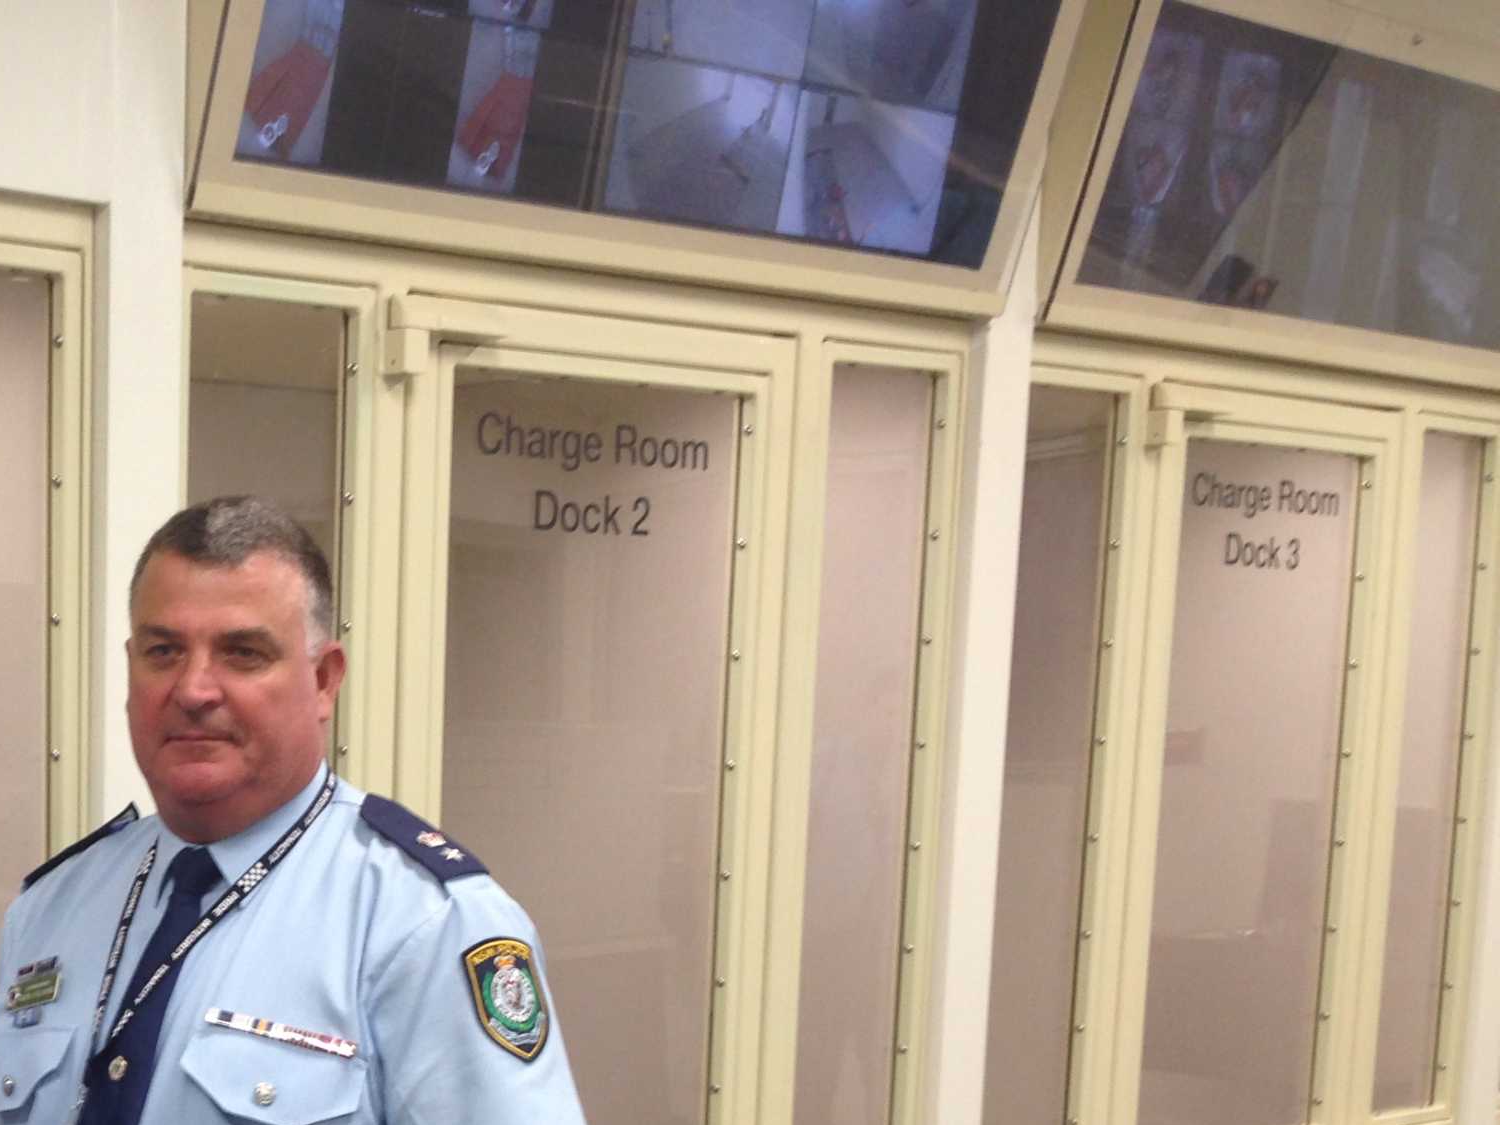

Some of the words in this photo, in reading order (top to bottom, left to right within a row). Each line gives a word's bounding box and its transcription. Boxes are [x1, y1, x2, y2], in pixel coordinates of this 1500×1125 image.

[476, 411, 603, 471] Charge
[615, 424, 709, 471] Room
[532, 490, 623, 536] Dock
[631, 496, 651, 537] 2
[1191, 471, 1273, 518] Charge
[1277, 480, 1340, 517] Room
[1224, 532, 1281, 568] Dock
[1286, 538, 1300, 571] 3
